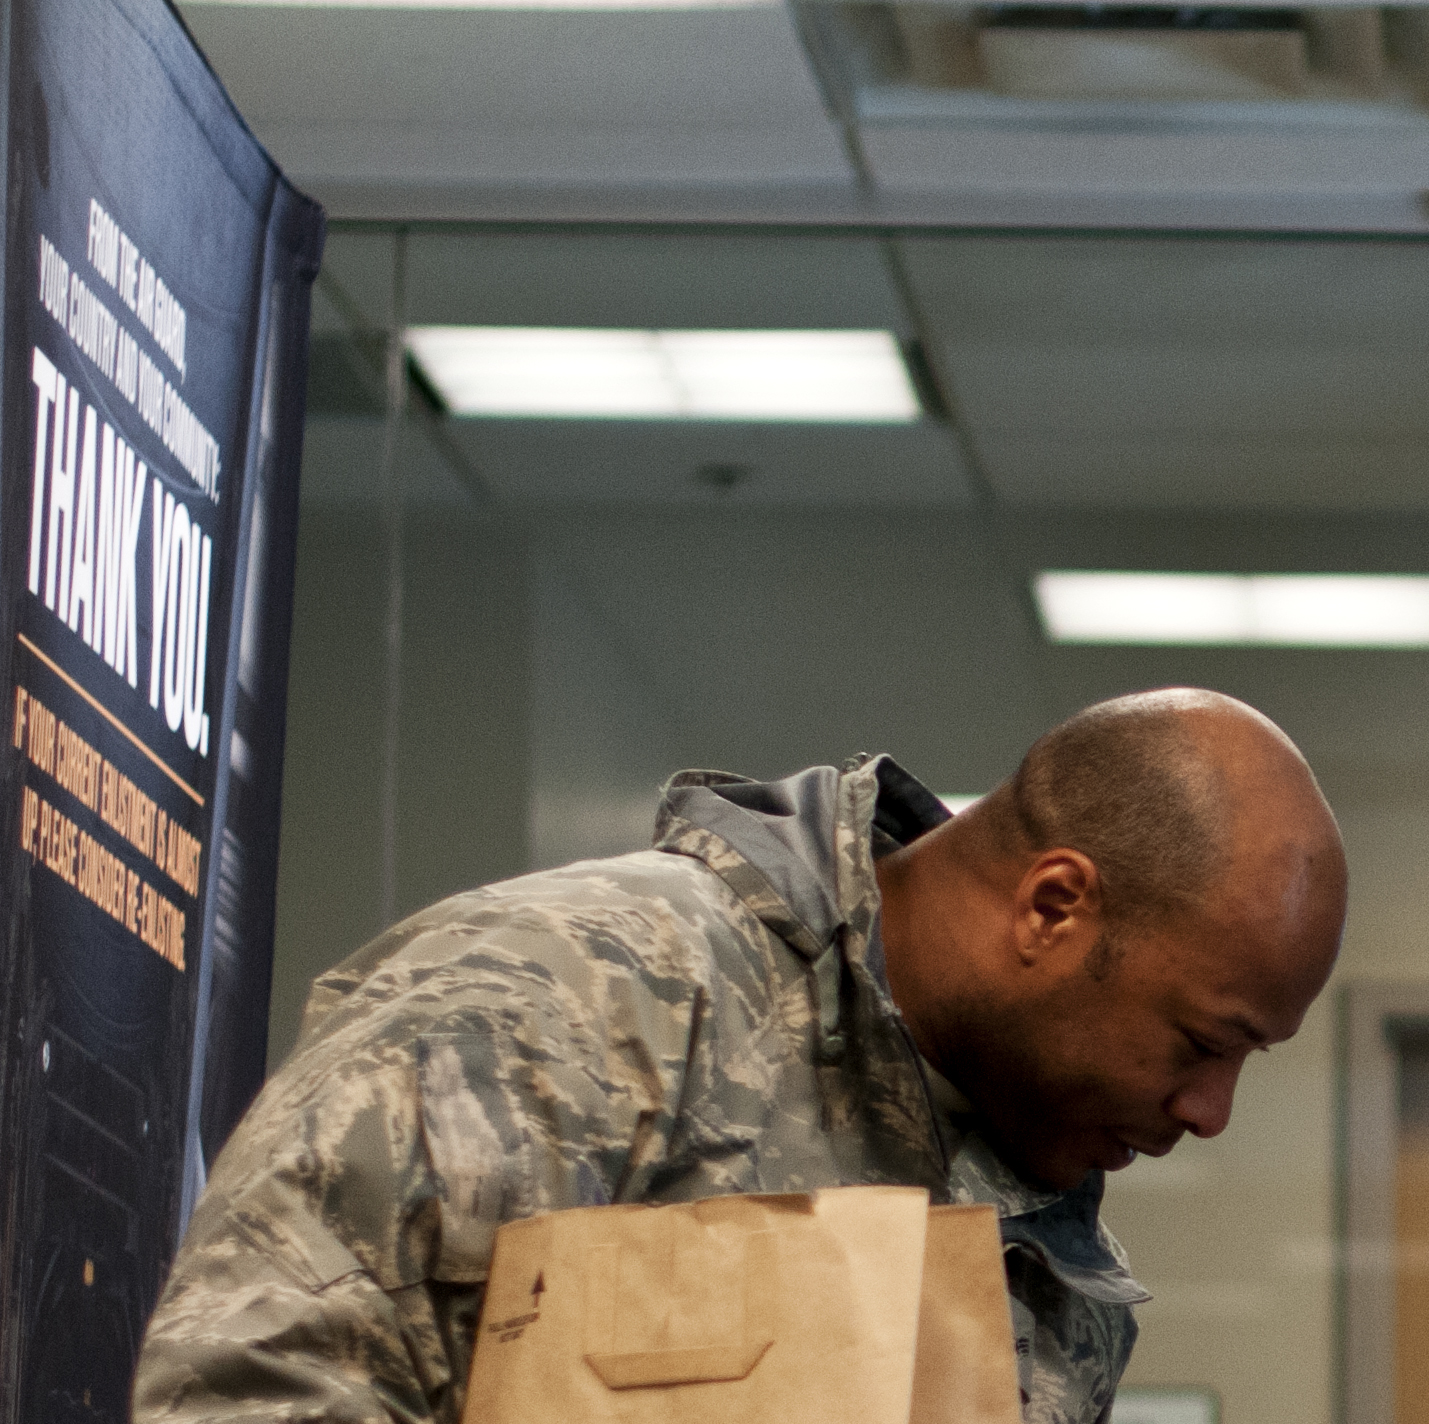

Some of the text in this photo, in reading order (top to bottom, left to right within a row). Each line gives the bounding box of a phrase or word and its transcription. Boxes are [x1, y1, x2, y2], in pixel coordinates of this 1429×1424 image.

[40, 234, 69, 329] YOUR
[69, 272, 117, 381] COUNTRY
[116, 326, 138, 405] AND
[138, 349, 164, 438] YOUR
[119, 232, 139, 312] THE
[137, 258, 155, 333] AIR
[28, 346, 212, 759] THANK YOU.
[14, 684, 202, 899] IF YOUR CURRENT ENLISTMENT IS ALMOST
[22, 785, 38, 866] UP,
[39, 800, 78, 886] PLEASE
[77, 829, 126, 923] CONSIDER
